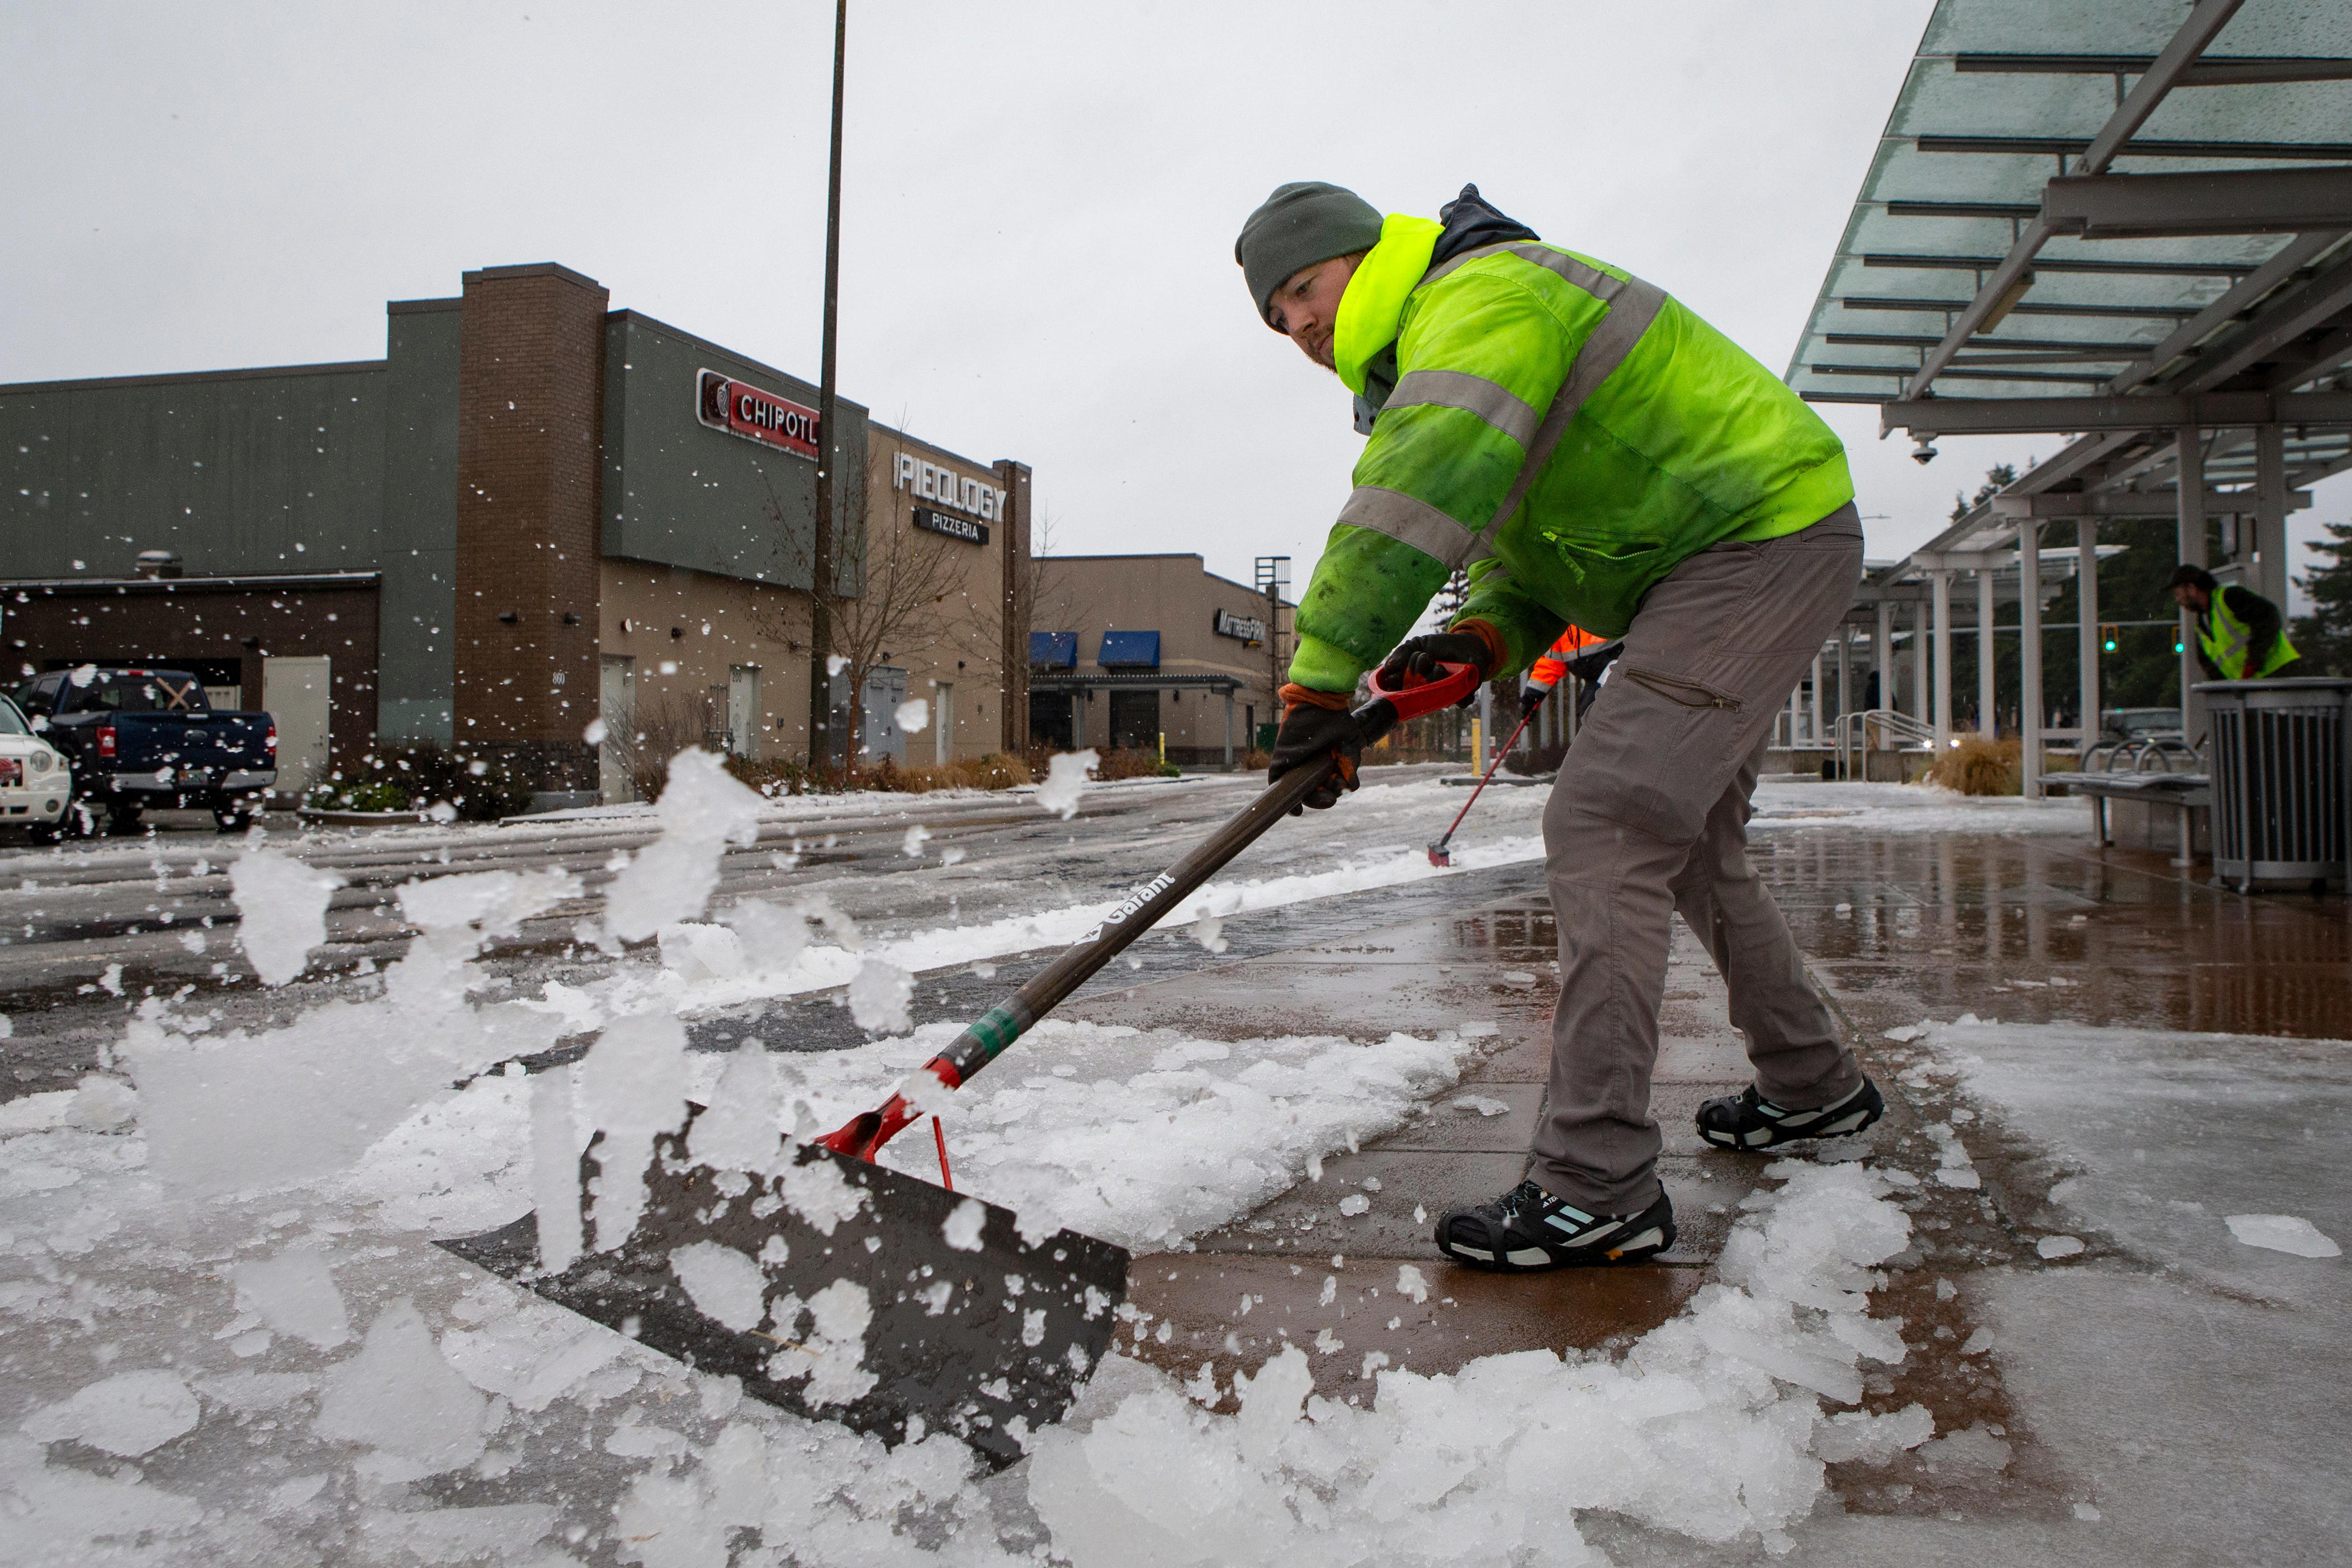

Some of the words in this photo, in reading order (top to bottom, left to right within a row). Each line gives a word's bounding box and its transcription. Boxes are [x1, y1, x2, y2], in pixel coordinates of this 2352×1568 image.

[741, 394, 818, 445] CHIPOTL
[893, 451, 1007, 523] PIEOLOGY
[932, 512, 979, 540] PIZZERIA
[552, 672, 565, 684] 860
[1104, 872, 1176, 924] Garant
